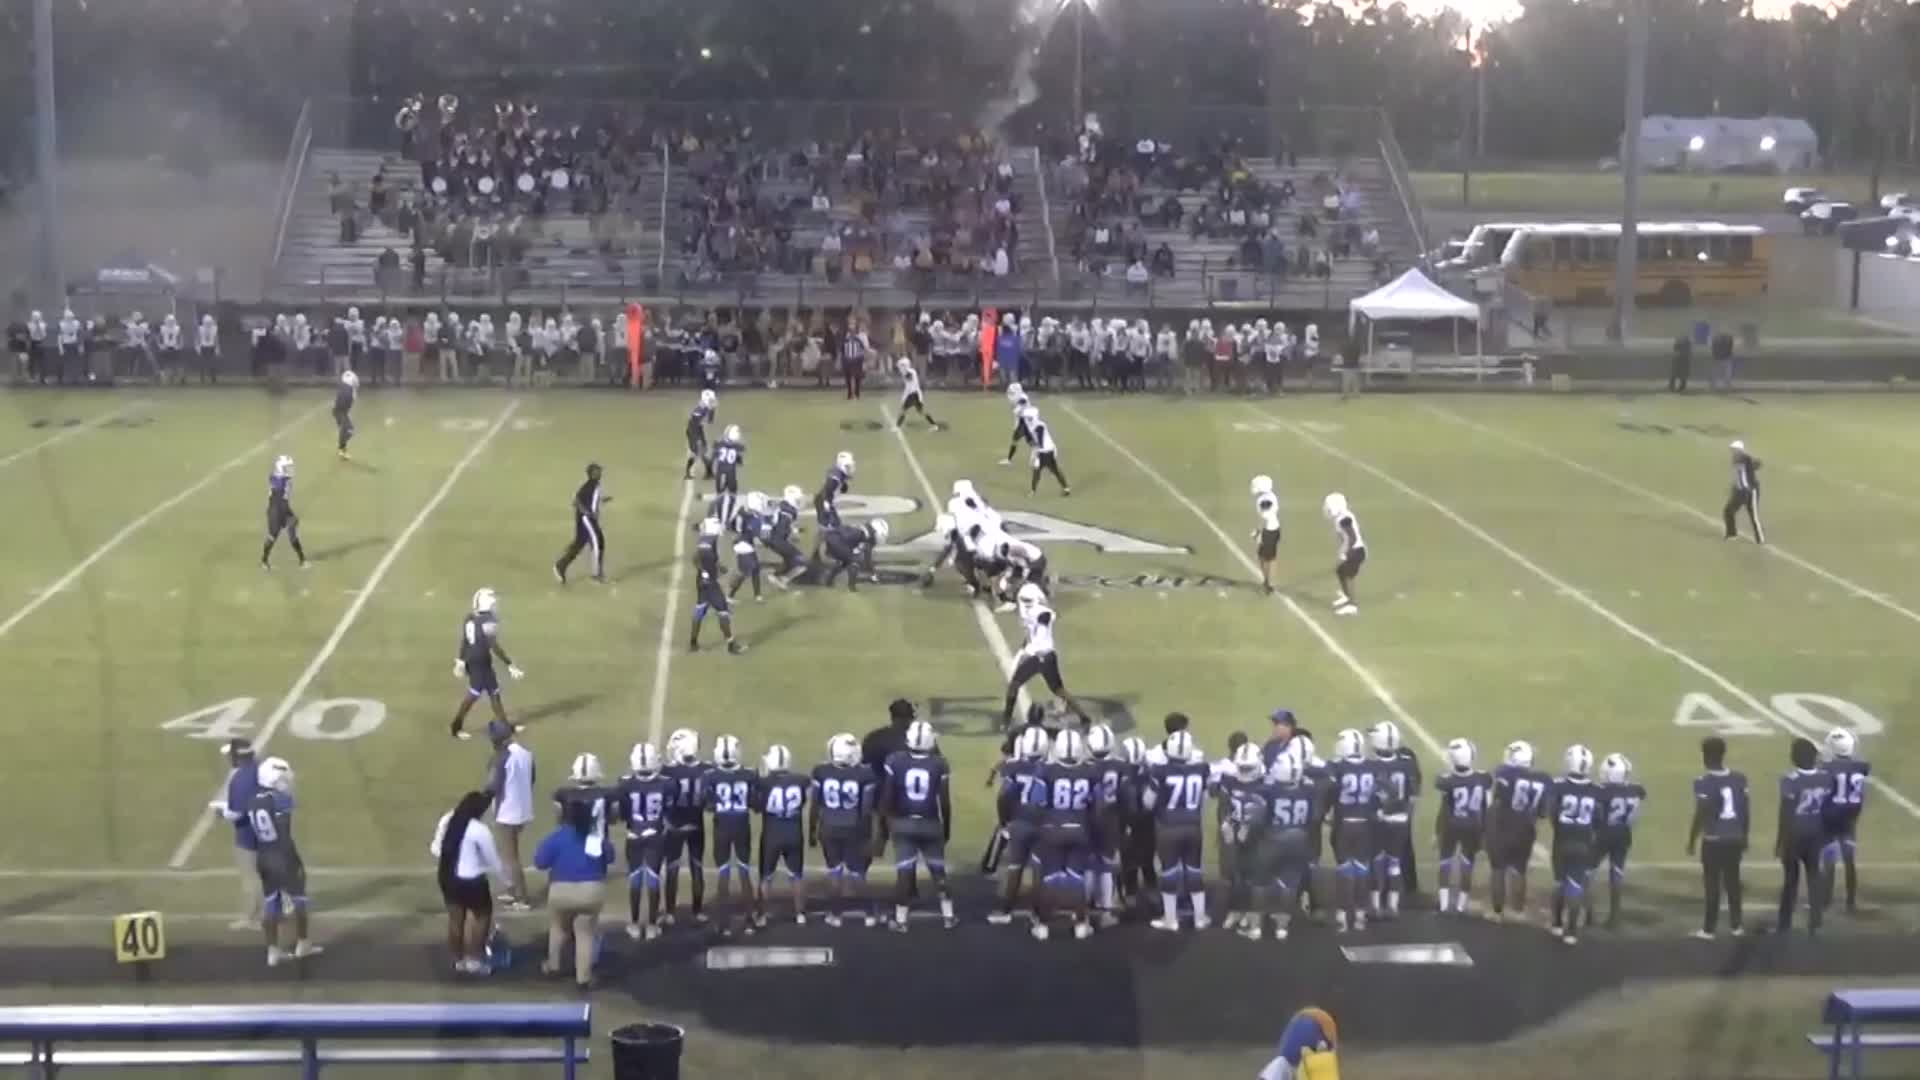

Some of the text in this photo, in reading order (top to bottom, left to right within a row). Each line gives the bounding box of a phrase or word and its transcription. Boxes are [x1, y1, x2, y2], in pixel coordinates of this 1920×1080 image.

[158, 697, 388, 740] 40
[1673, 692, 1885, 736] 40
[905, 768, 930, 801] 0
[1165, 773, 1203, 810] 70
[1719, 786, 1737, 819] 1
[122, 916, 160, 958] 40
